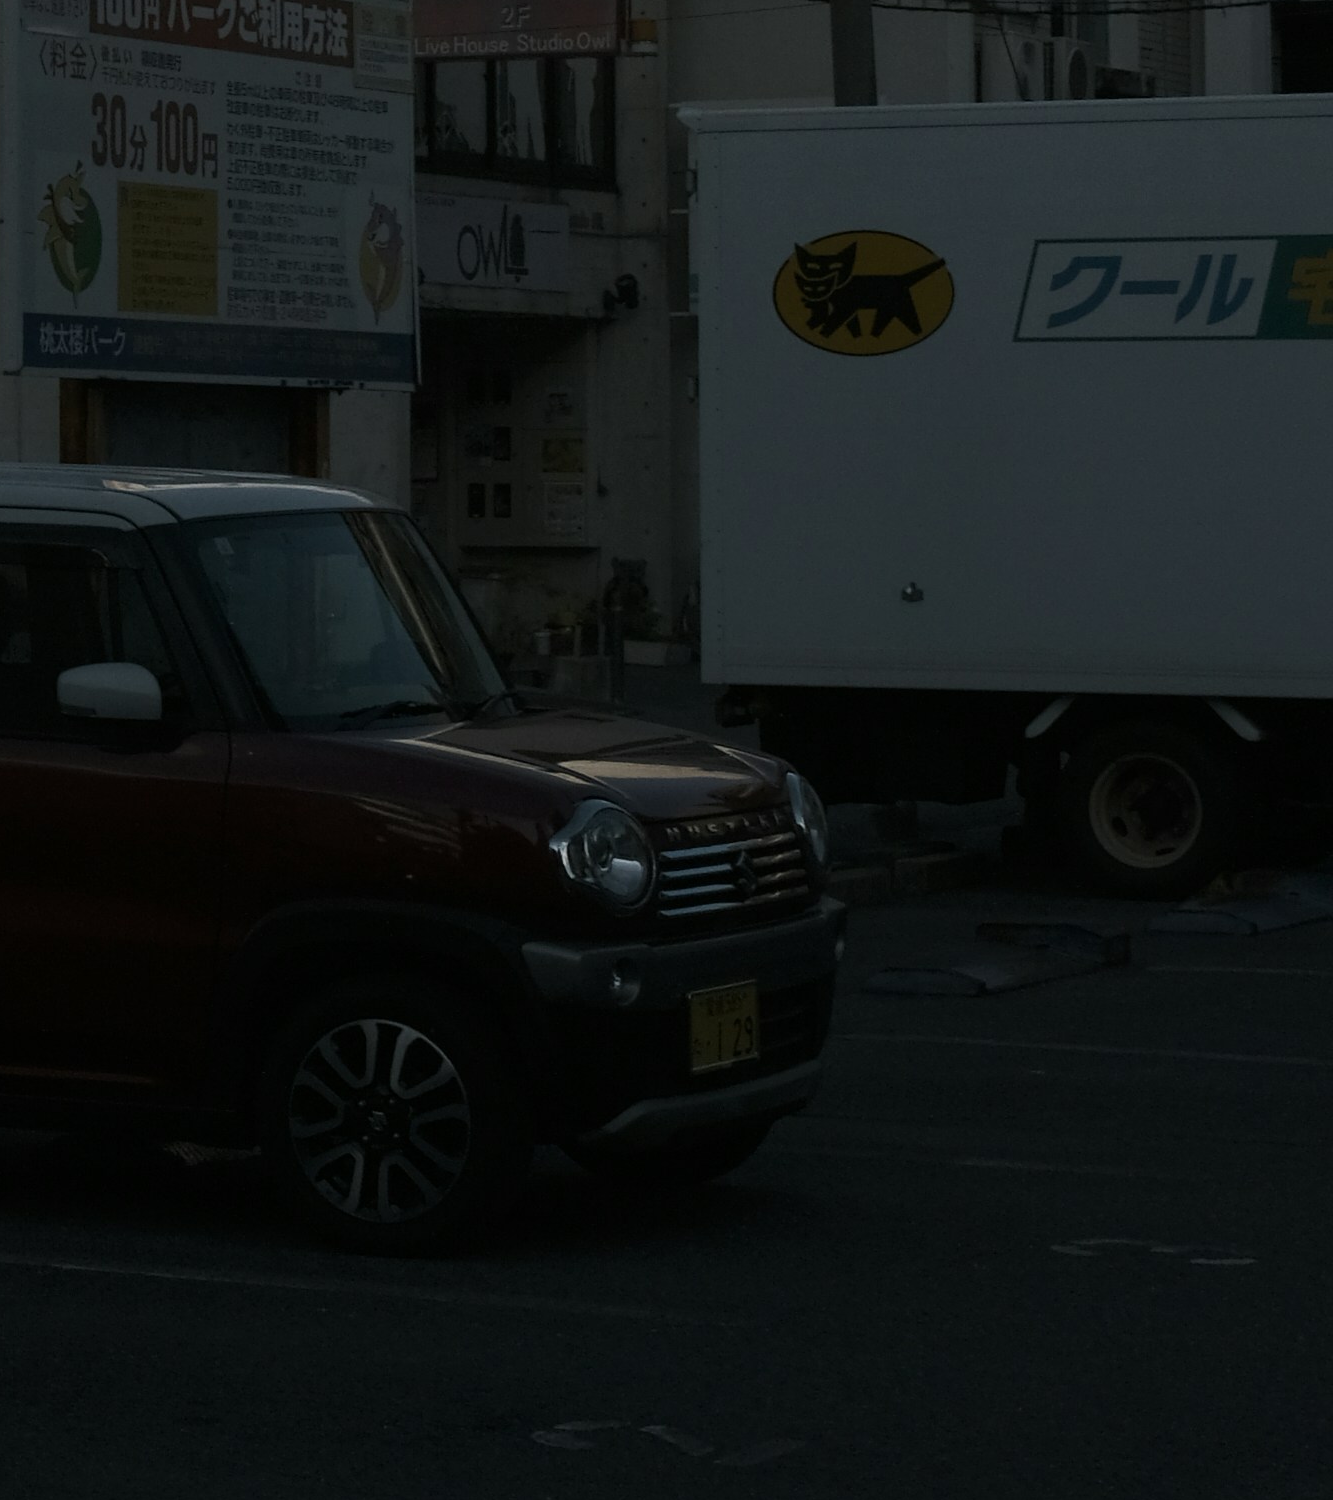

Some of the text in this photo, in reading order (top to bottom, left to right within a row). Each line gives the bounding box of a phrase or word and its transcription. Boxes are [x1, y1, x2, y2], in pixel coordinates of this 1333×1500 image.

[500, 5, 532, 29] 2F
[414, 31, 611, 55] Live House Studio Owl
[1046, 253, 1255, 330] クール
